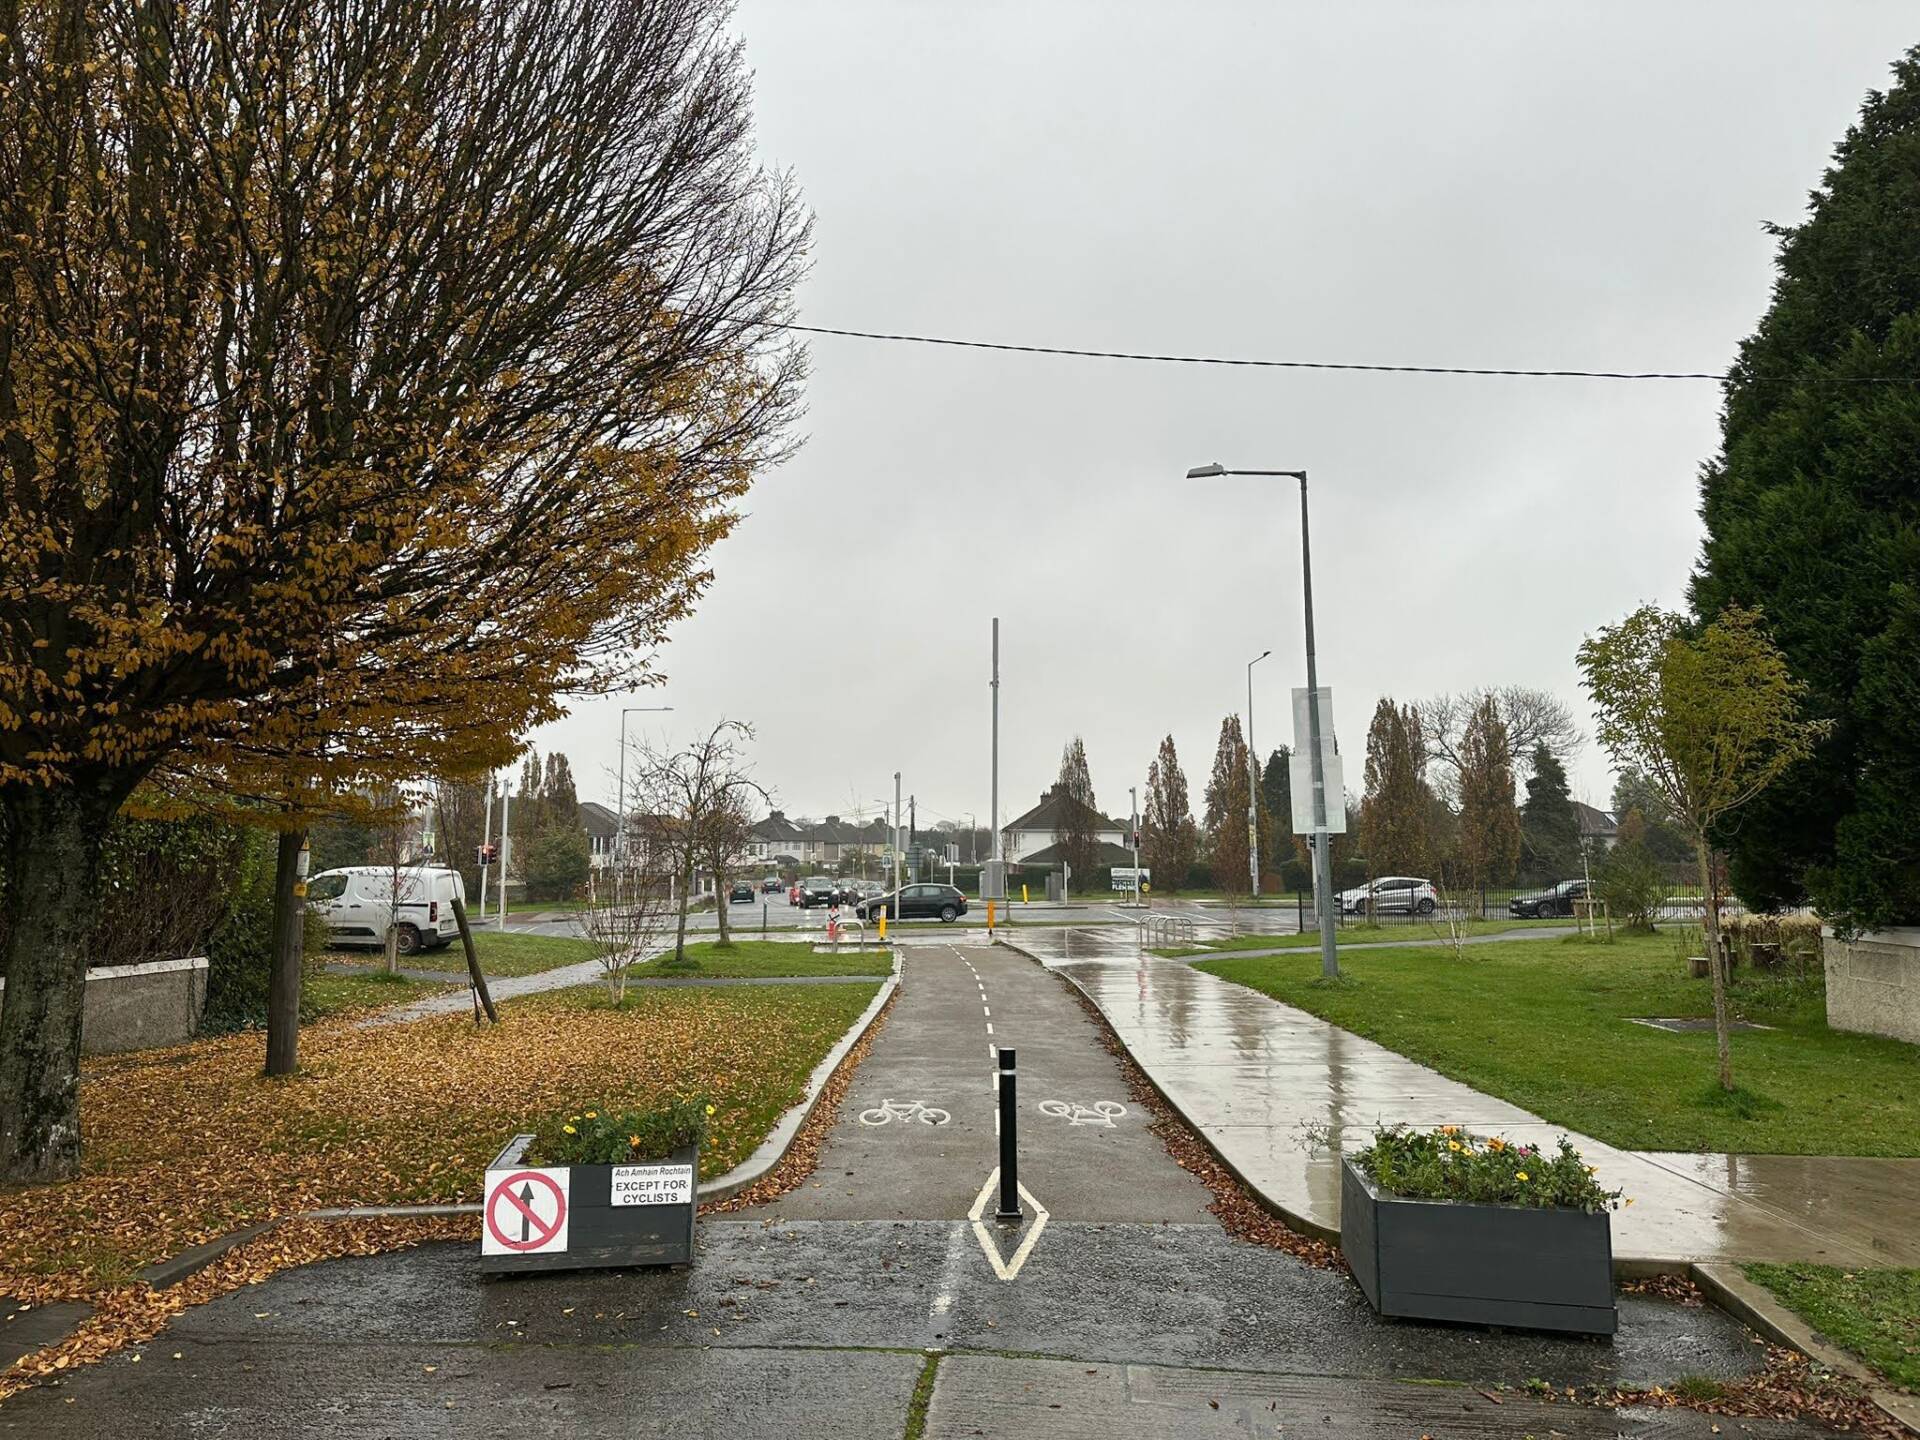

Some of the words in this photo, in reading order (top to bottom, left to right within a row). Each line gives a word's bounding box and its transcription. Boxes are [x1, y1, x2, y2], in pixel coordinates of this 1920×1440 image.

[615, 1168, 630, 1177] Ach
[660, 1166, 691, 1175] Rochtain
[616, 1181, 660, 1191] EXCEPT
[663, 1180, 687, 1190] FOR
[623, 1193, 678, 1203] CYCLISTS
